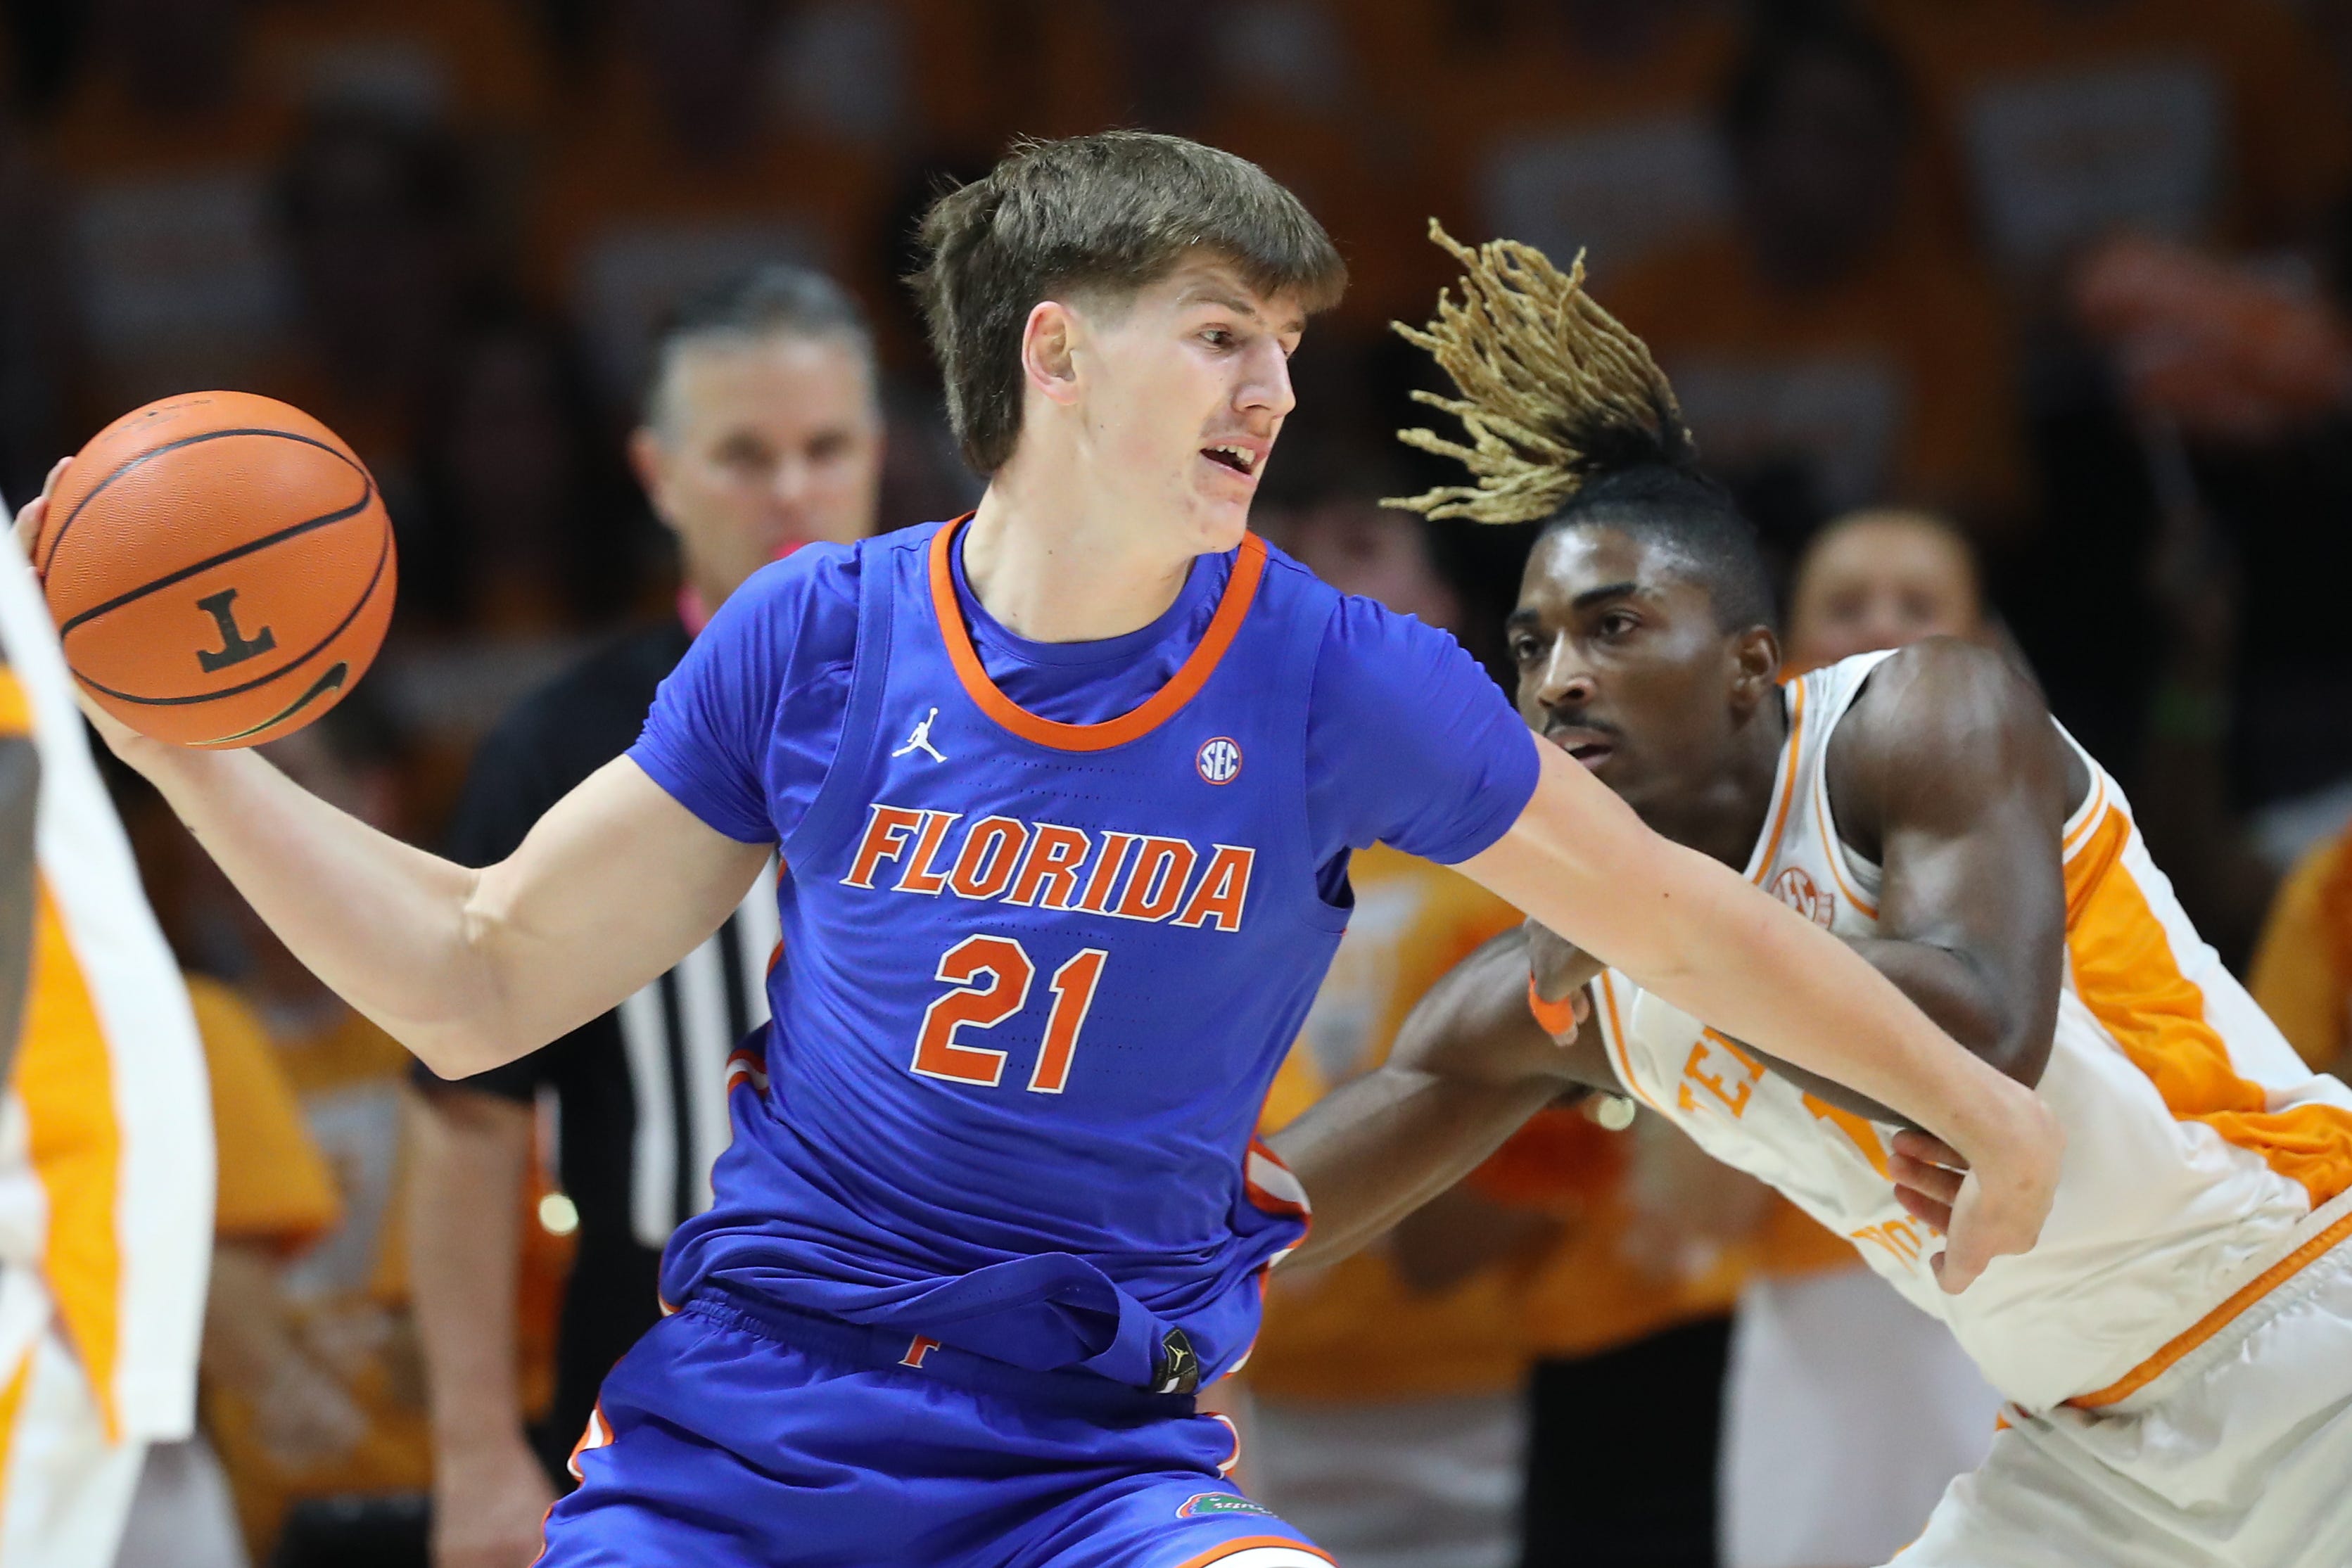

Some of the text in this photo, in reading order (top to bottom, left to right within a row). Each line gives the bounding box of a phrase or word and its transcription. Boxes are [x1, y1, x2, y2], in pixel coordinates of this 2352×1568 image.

[1200, 741, 1238, 780] SEC
[840, 803, 1256, 932] FLORIDA
[910, 933, 1109, 1094] 21
